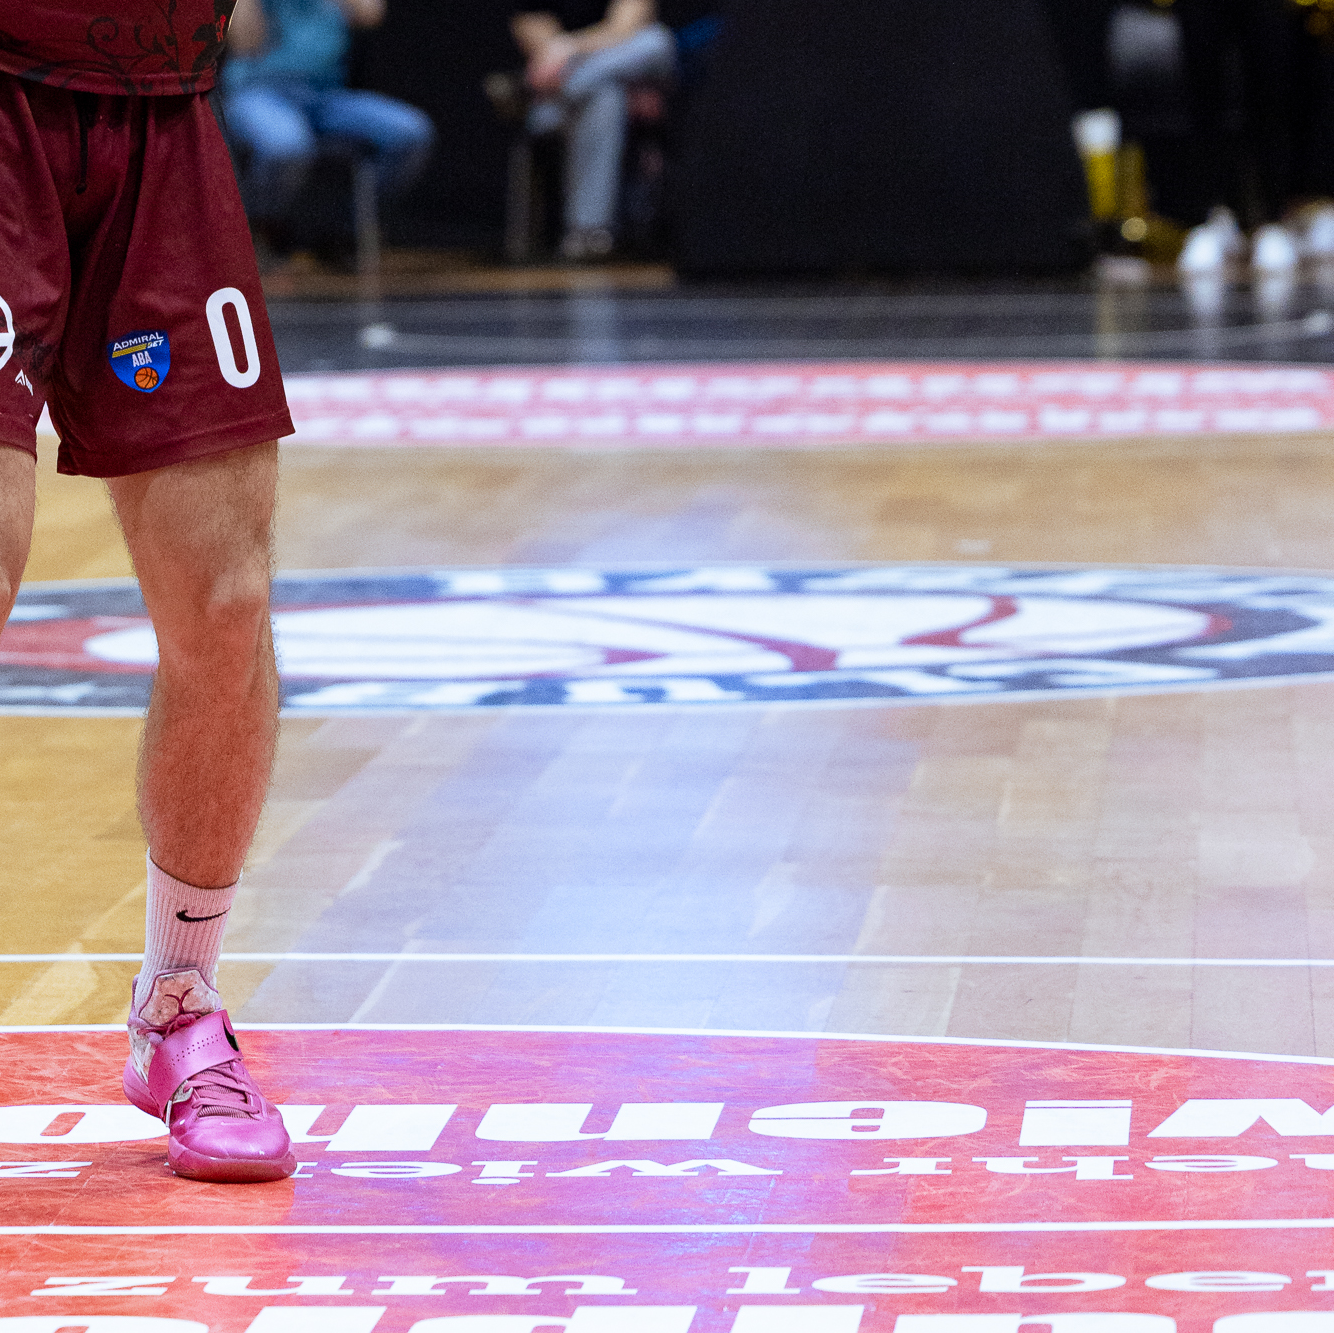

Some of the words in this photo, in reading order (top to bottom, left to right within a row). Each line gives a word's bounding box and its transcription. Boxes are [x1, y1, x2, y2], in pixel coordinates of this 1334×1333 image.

[113, 331, 164, 352] ADMIRAL
[205, 286, 262, 390] 0
[131, 350, 153, 368] ABA
[851, 1153, 1334, 1181] ehr
[29, 1274, 640, 1297] zum
[724, 1265, 1334, 1295] lebe
